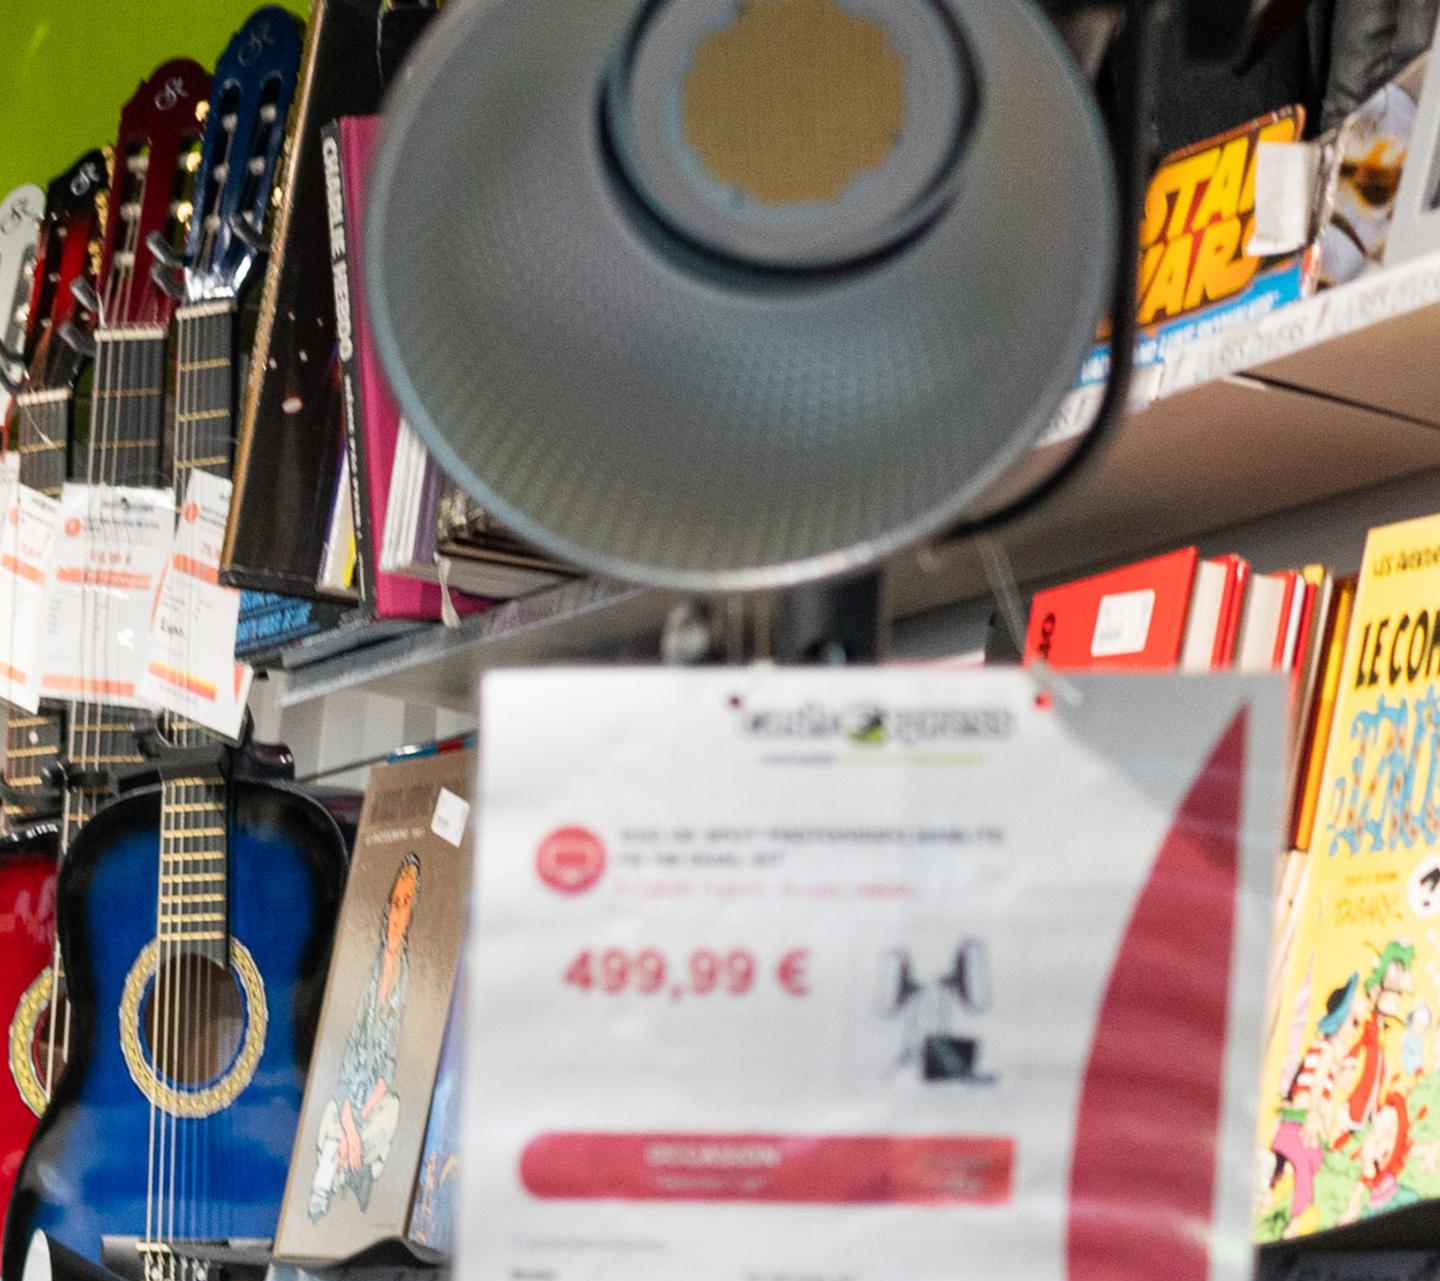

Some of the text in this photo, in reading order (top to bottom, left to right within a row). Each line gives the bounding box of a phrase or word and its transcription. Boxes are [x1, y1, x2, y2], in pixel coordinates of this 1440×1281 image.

[322, 136, 354, 362] CHARLIE HEBDO
[1136, 214, 1266, 324] ARS
[1355, 617, 1392, 689] LE
[562, 946, 811, 1002] 499,99 €
